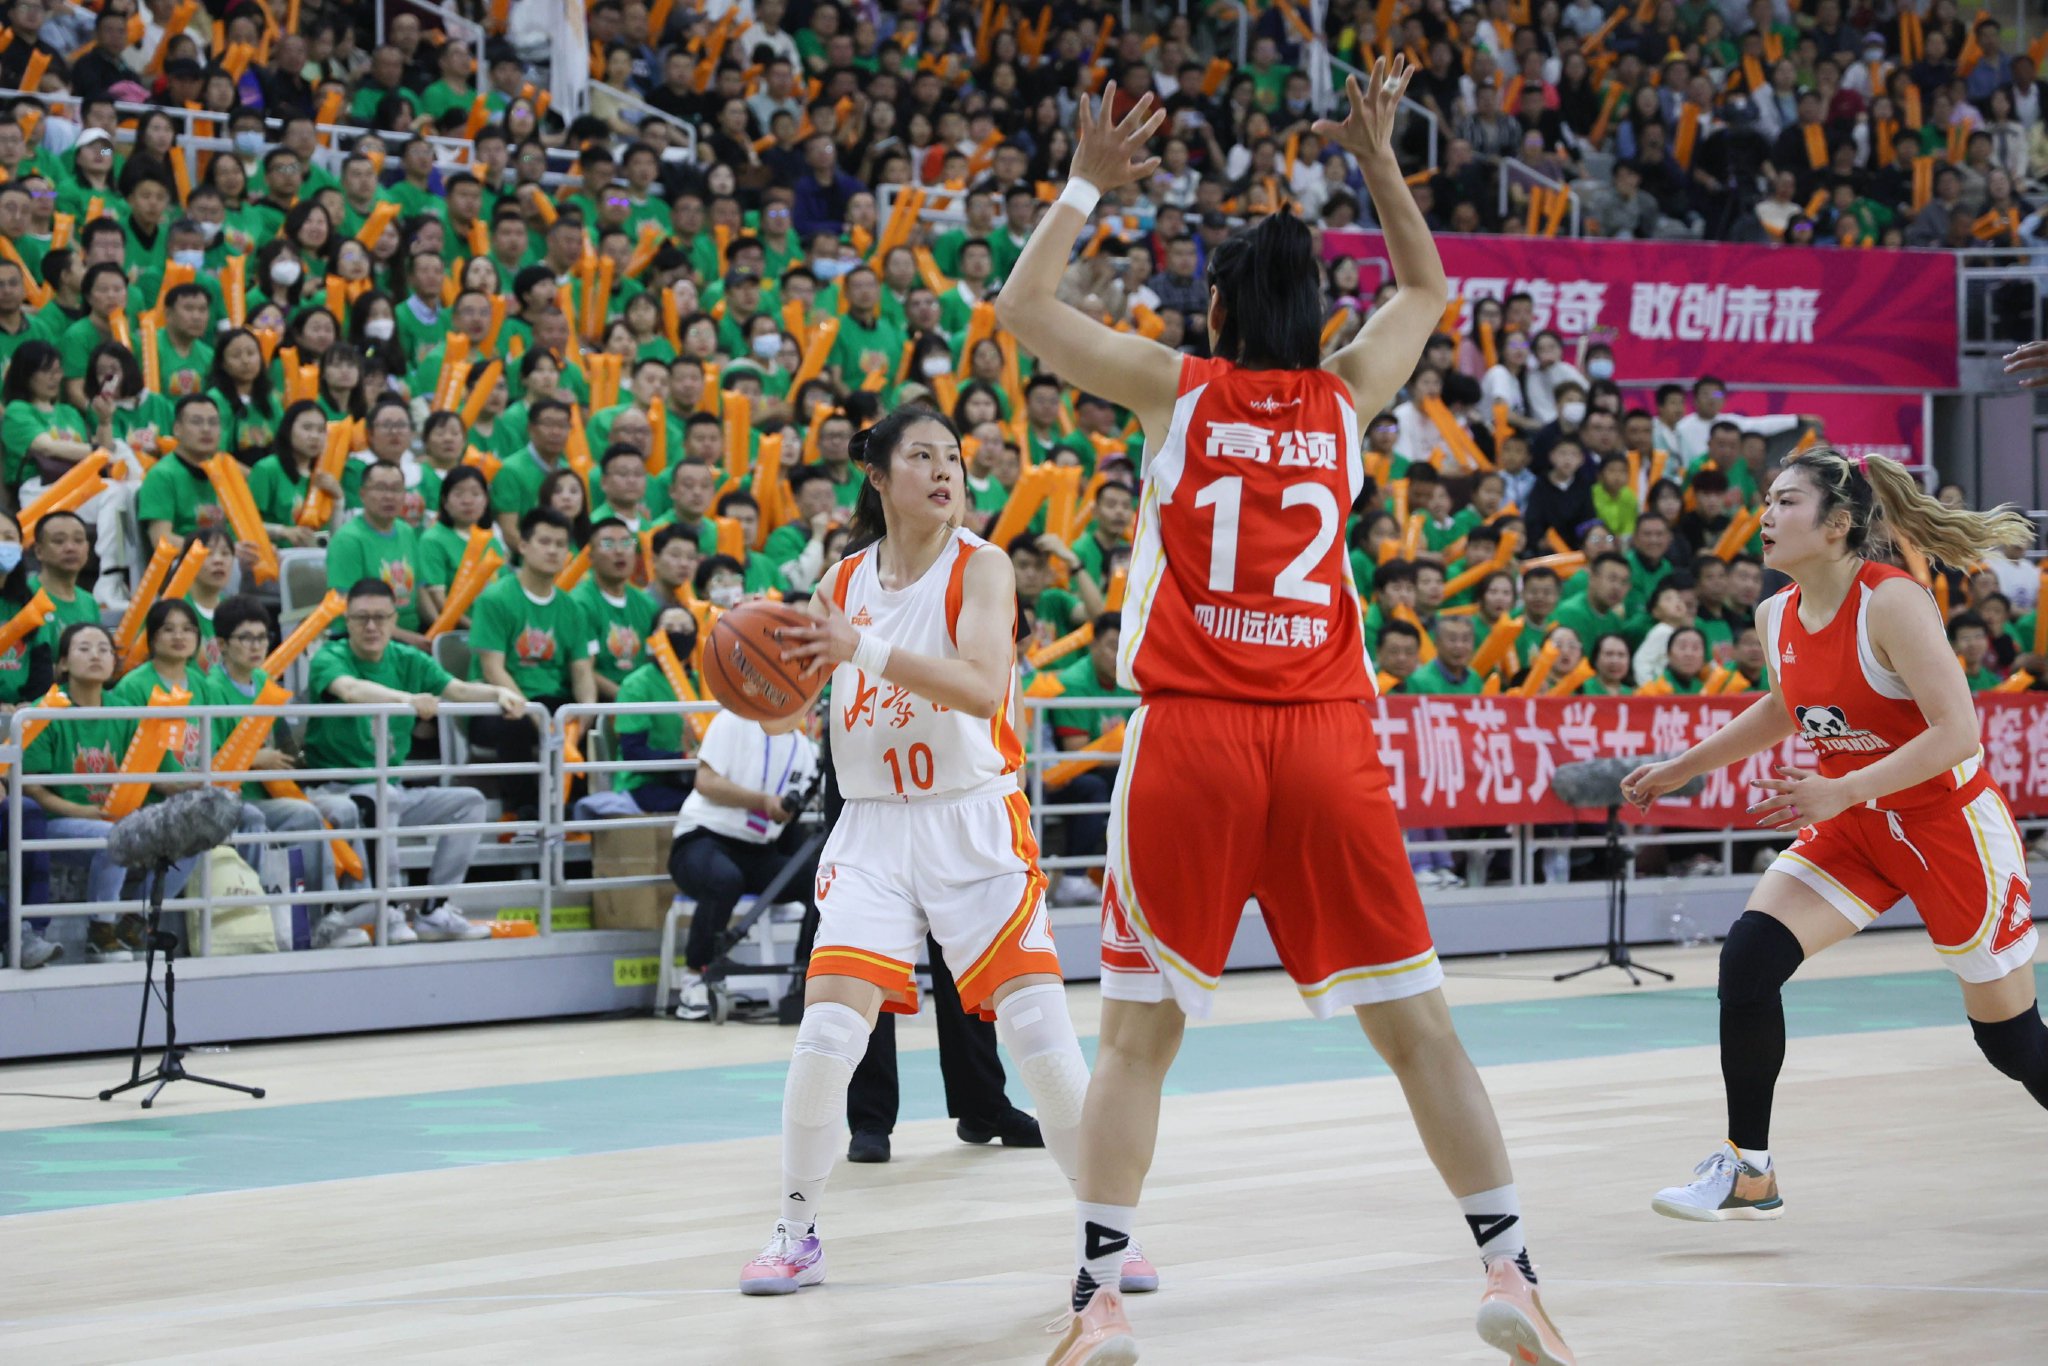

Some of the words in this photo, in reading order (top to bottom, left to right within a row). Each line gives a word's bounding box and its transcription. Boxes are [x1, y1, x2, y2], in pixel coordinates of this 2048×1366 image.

[1629, 282, 1821, 343] 敢创未来
[1205, 420, 1338, 470] 高颂
[1194, 475, 1340, 606] 12
[843, 671, 950, 732] 内蒙
[882, 742, 934, 794] 10
